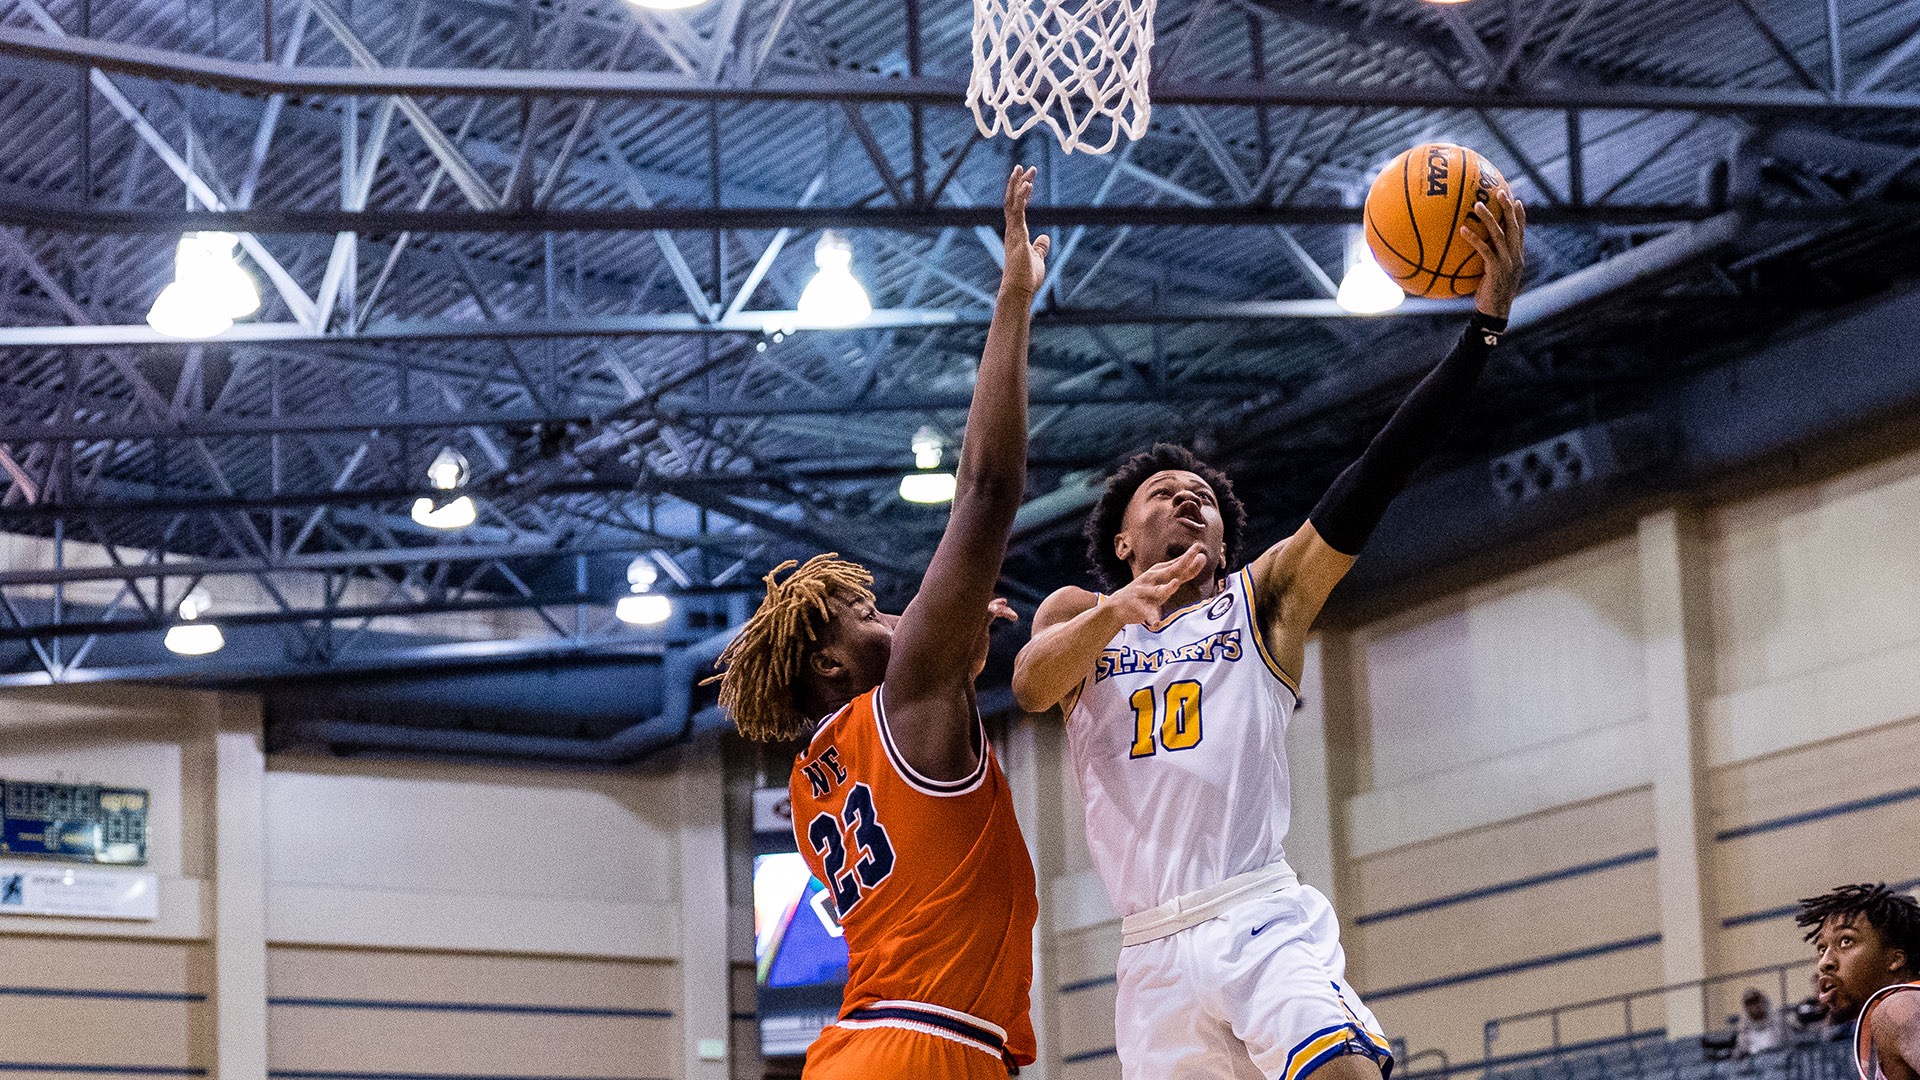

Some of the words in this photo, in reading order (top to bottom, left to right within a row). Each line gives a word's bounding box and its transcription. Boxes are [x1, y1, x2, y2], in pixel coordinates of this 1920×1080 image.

[1129, 679, 1203, 760] 10
[800, 745, 848, 798] NE
[808, 781, 896, 919] 23
